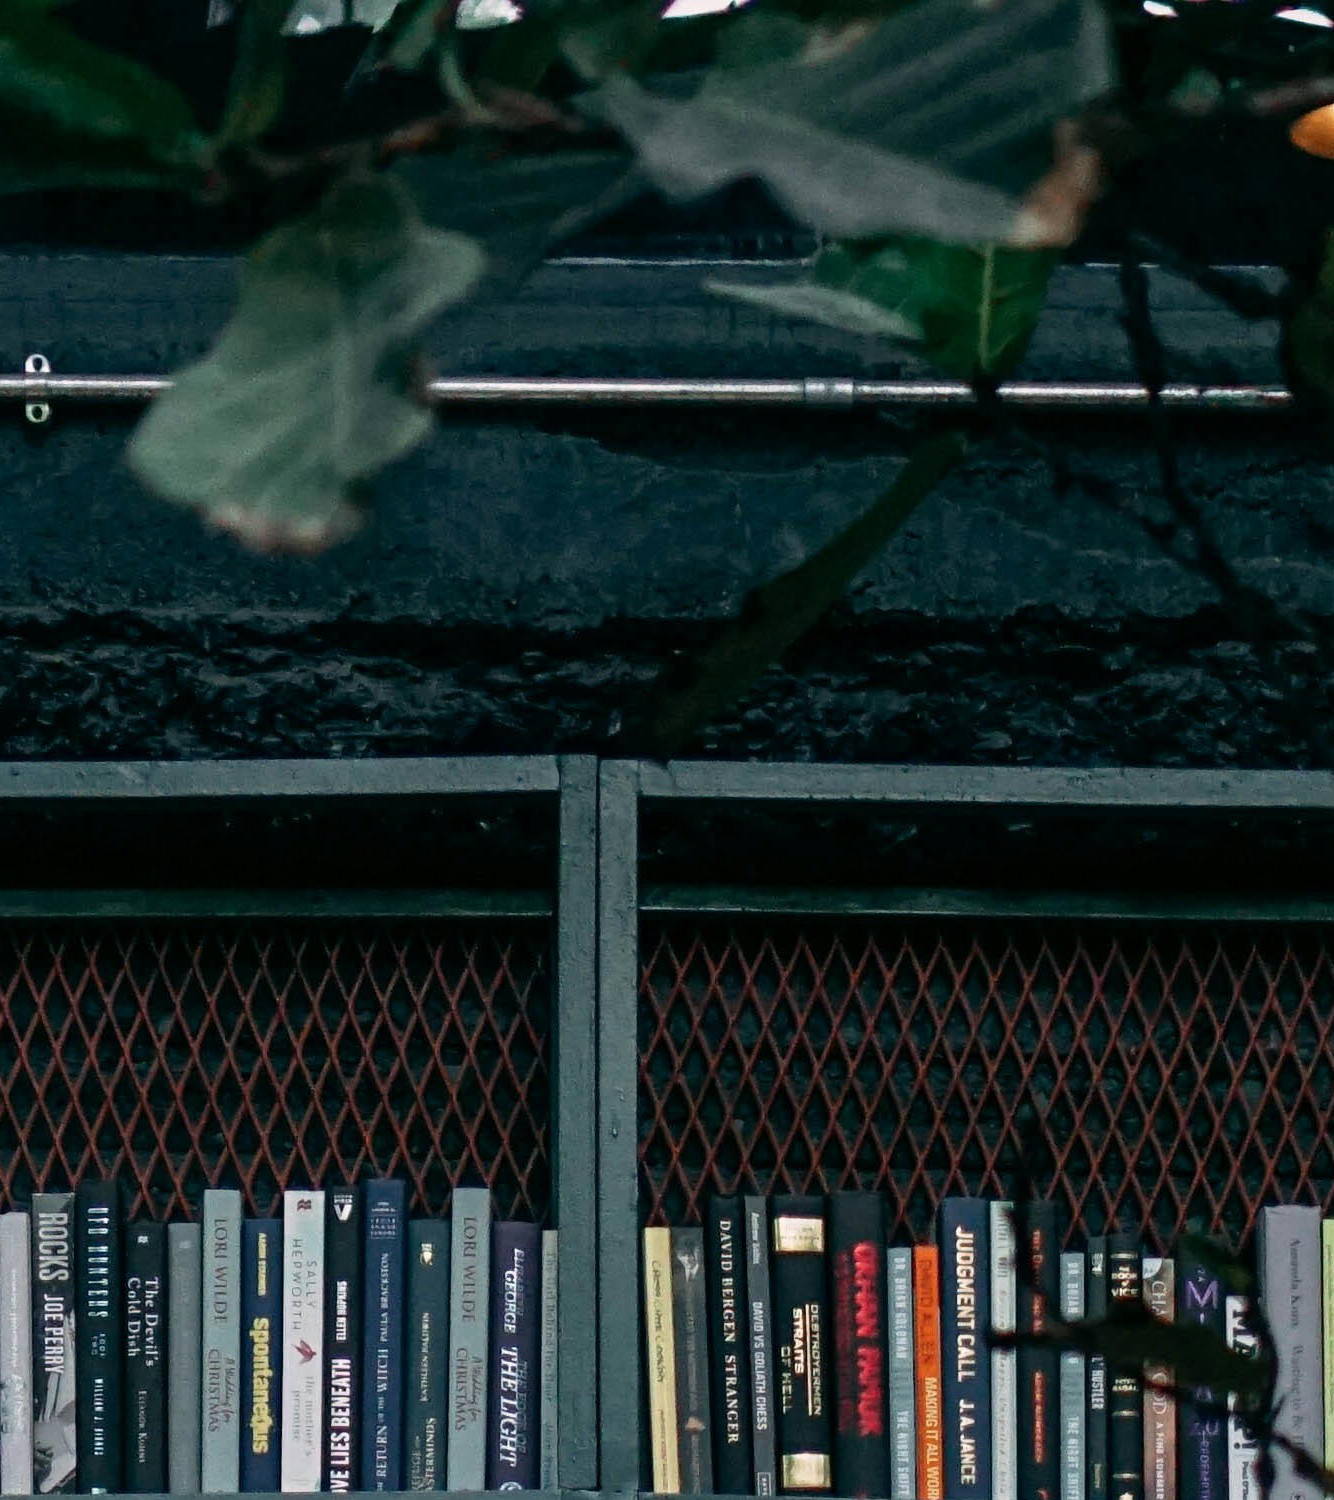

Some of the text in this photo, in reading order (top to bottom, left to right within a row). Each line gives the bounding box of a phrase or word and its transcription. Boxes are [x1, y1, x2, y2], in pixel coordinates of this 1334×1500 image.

[39, 1212, 68, 1280] ROCKS
[87, 1207, 110, 1318] UFO HUNTERS
[719, 1220, 736, 1342] DAVID BERGEN
[44, 1294, 65, 1373] JOE PERRY
[128, 1278, 141, 1356] Cold Dish
[955, 1226, 976, 1381] JUDGMENT CALL
[330, 1359, 350, 1467] LIES BENEATH
[499, 1346, 518, 1467] THE LIGHT
[724, 1355, 739, 1443] STRANGER
